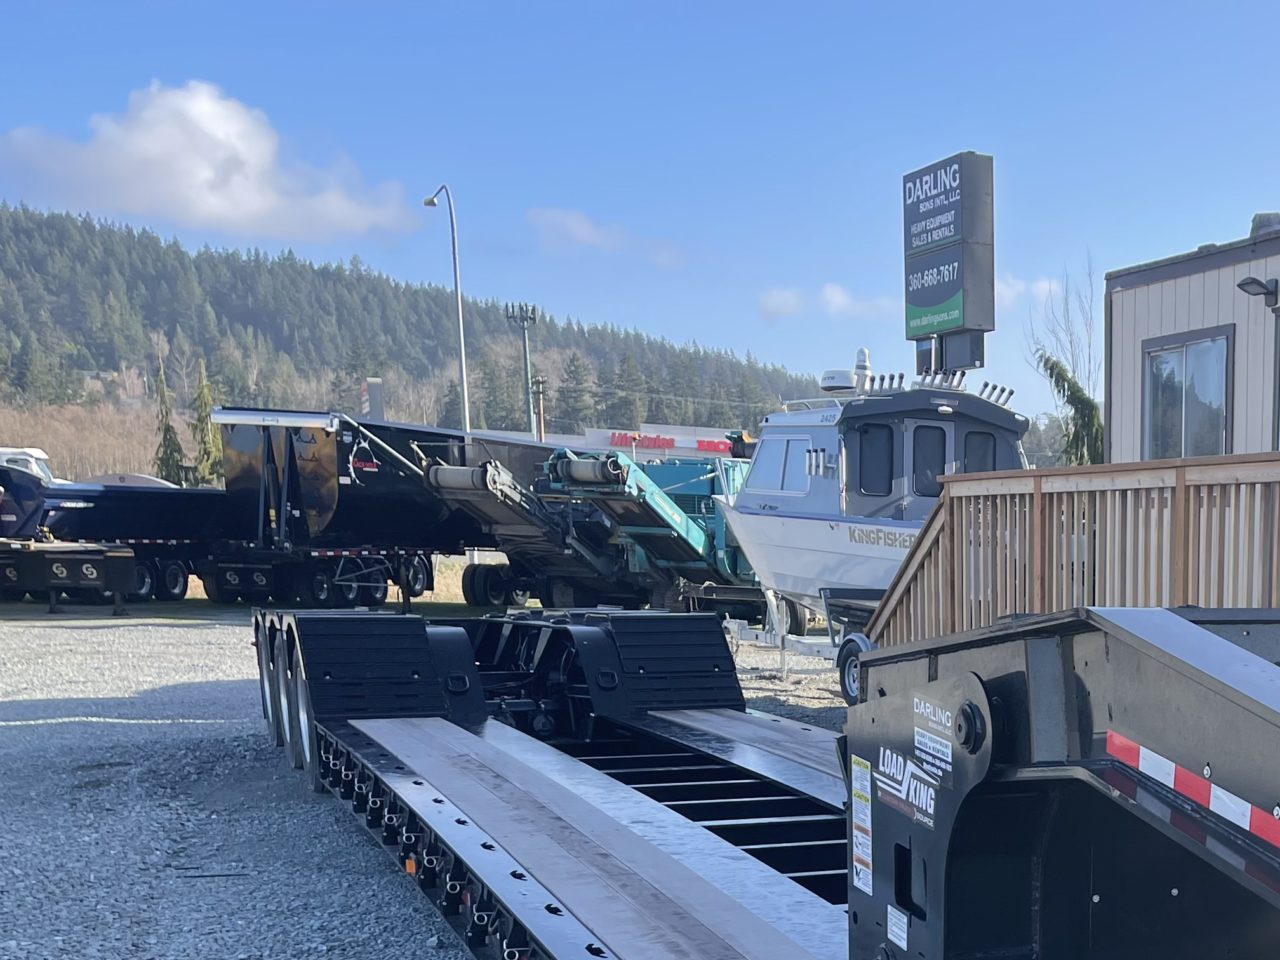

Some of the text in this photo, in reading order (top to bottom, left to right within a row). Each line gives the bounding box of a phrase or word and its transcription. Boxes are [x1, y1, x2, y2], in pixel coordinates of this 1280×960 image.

[905, 163, 960, 205] DARLING
[919, 199, 934, 213] SONS
[949, 189, 961, 202] LLC
[910, 210, 955, 235] HEAVY EQUIPMENT
[911, 233, 928, 248] SALES
[932, 224, 955, 240] RENTALS
[908, 261, 959, 292] 360-668-7617
[913, 697, 952, 727] DARLING
[879, 746, 904, 781] LOAD
[908, 777, 935, 815] KING
